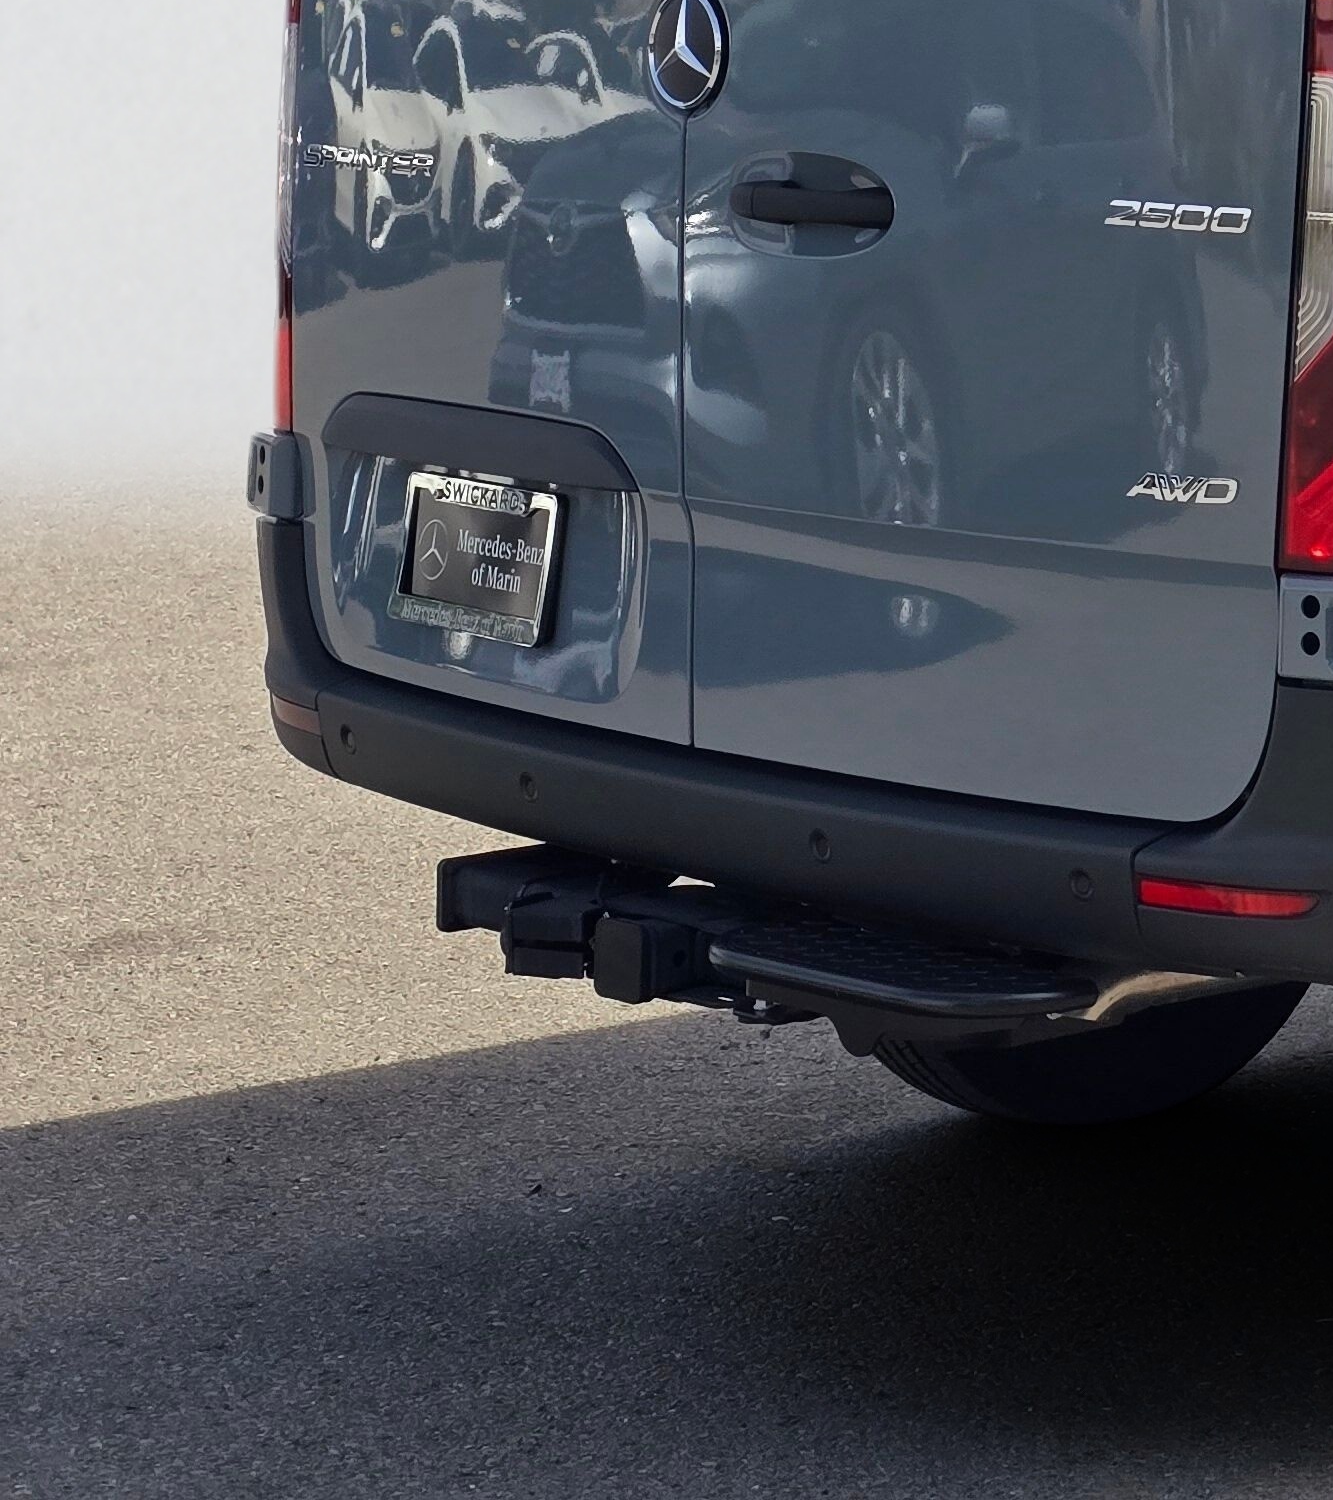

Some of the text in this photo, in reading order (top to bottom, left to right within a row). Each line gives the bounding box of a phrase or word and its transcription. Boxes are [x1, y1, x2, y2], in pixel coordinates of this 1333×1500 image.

[303, 144, 434, 177] SPRINTER
[1104, 199, 1251, 234] 2500
[444, 481, 521, 511] SWICKARD
[1126, 472, 1238, 504] AWD
[457, 529, 544, 565] Mercedes-Benz
[471, 563, 521, 594] of Marin
